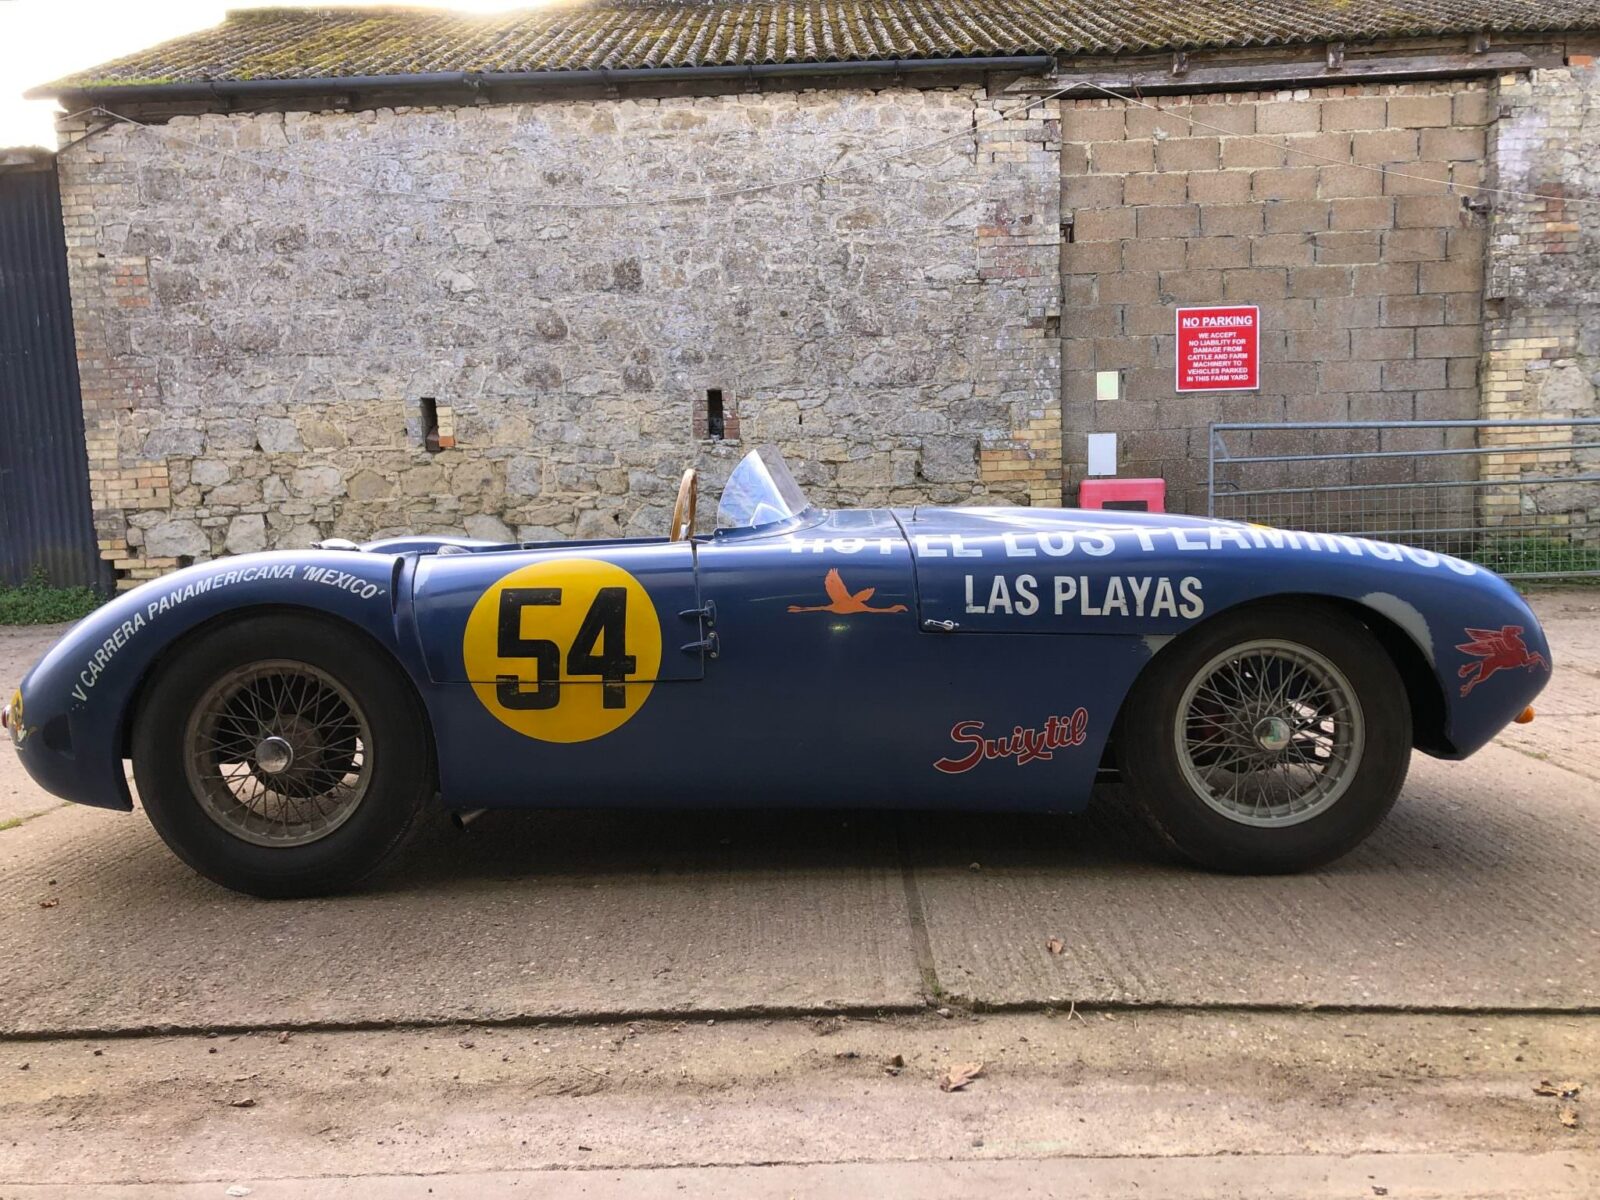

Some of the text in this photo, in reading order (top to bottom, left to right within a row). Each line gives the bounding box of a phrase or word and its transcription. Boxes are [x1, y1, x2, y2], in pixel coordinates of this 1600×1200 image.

[1182, 316, 1253, 327] NO PARKING
[1001, 530, 1116, 557] LOS
[965, 574, 1204, 620] LAS PLAYAS
[71, 684, 87, 702] V
[80, 612, 146, 688] CARRERA
[147, 564, 297, 621] PANAMERICANA
[496, 587, 637, 711] 54
[933, 706, 1089, 774] Suixtil
